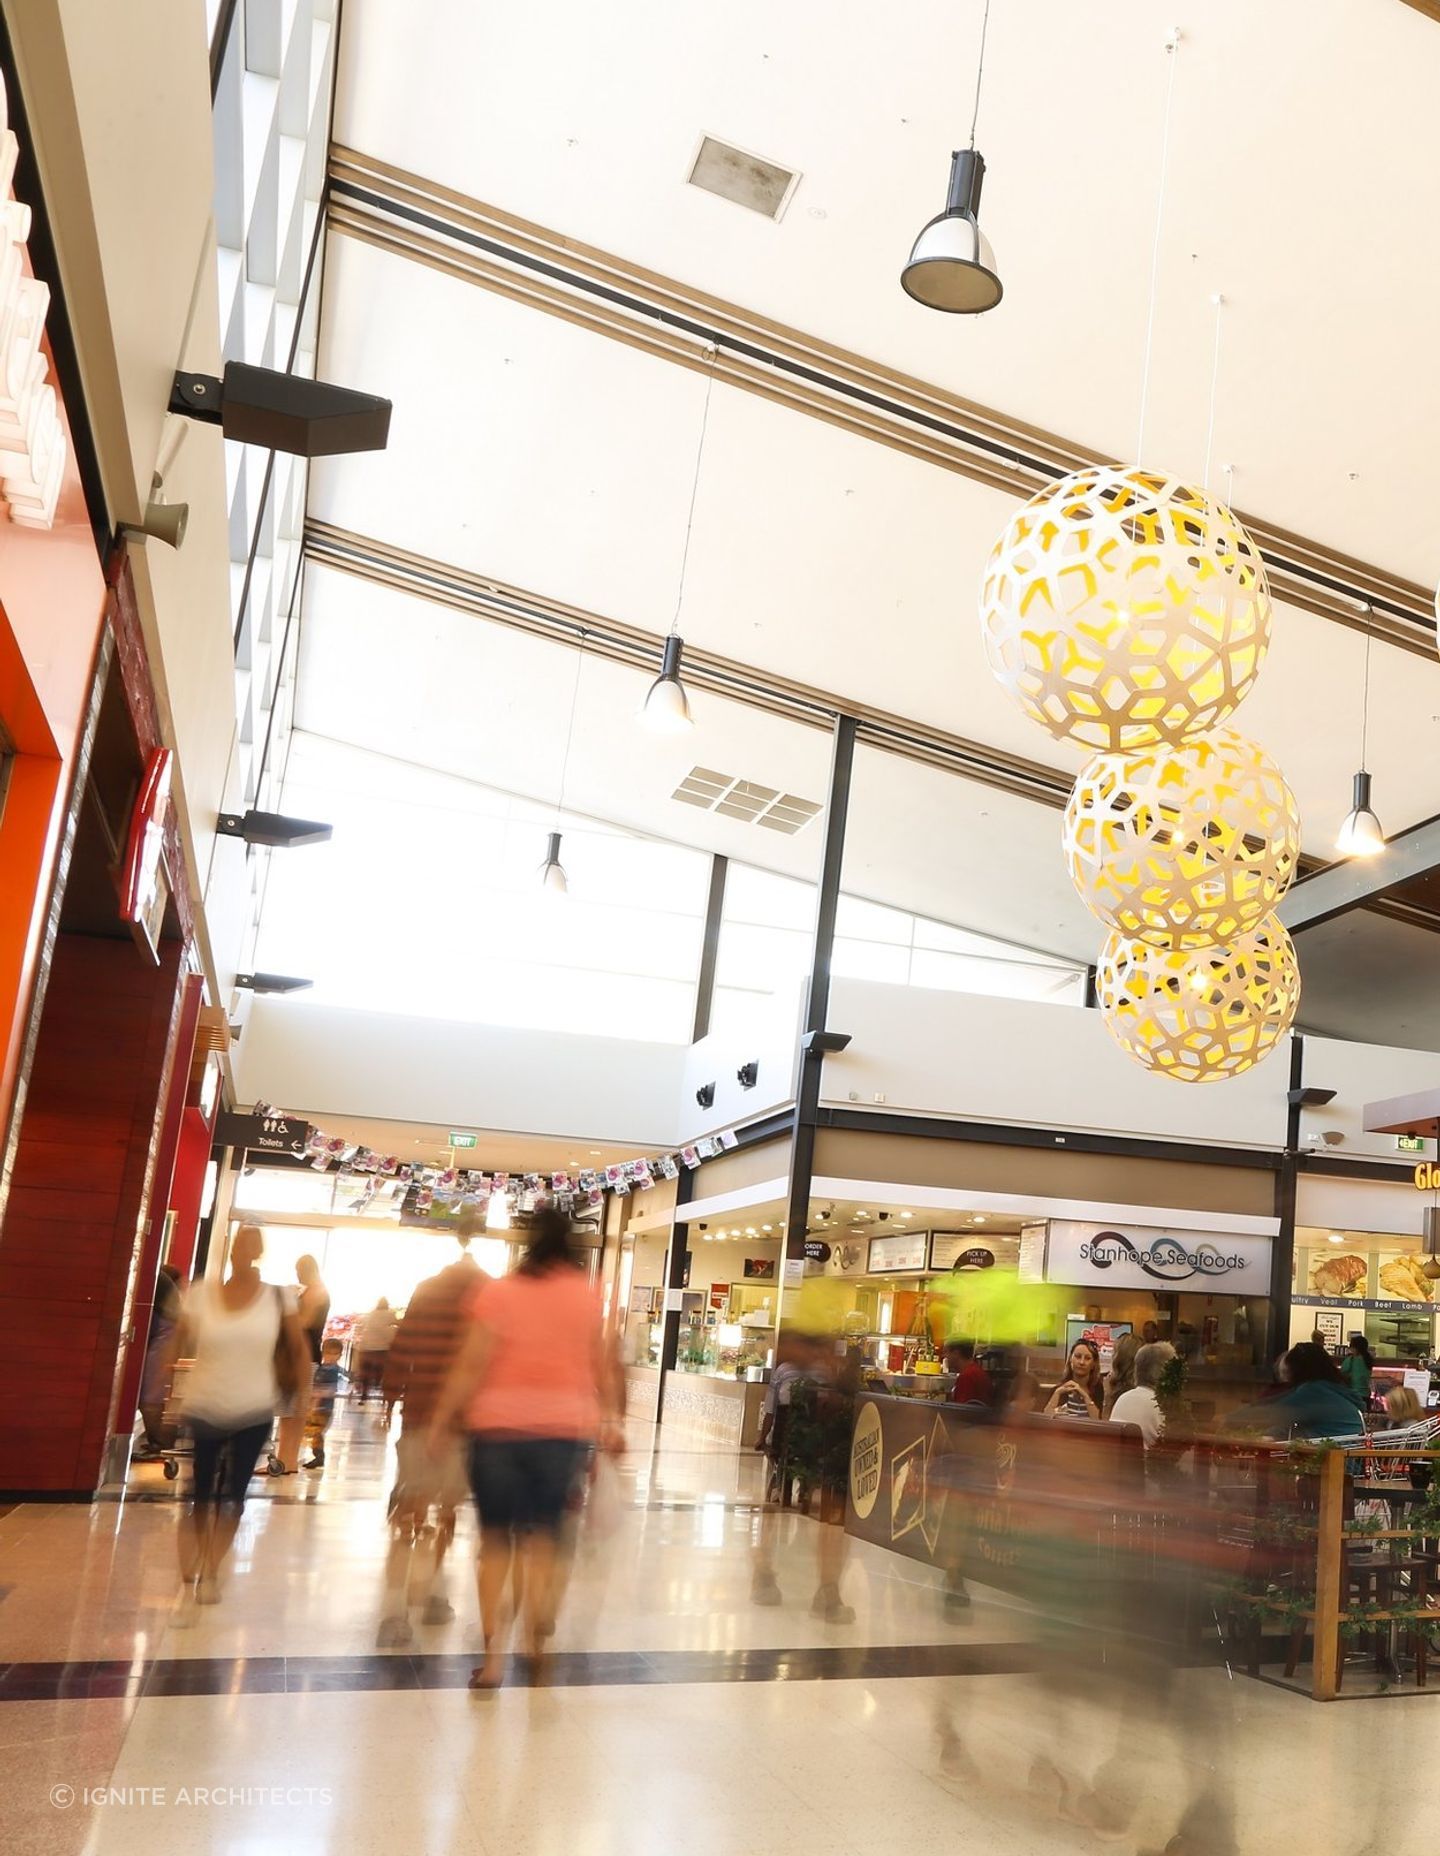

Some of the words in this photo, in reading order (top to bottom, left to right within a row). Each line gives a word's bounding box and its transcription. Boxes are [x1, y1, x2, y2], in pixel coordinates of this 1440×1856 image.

[258, 1137, 284, 1148] Toilets
[1079, 1242, 1163, 1265] Stanhope
[1167, 1249, 1245, 1269] Seafoods
